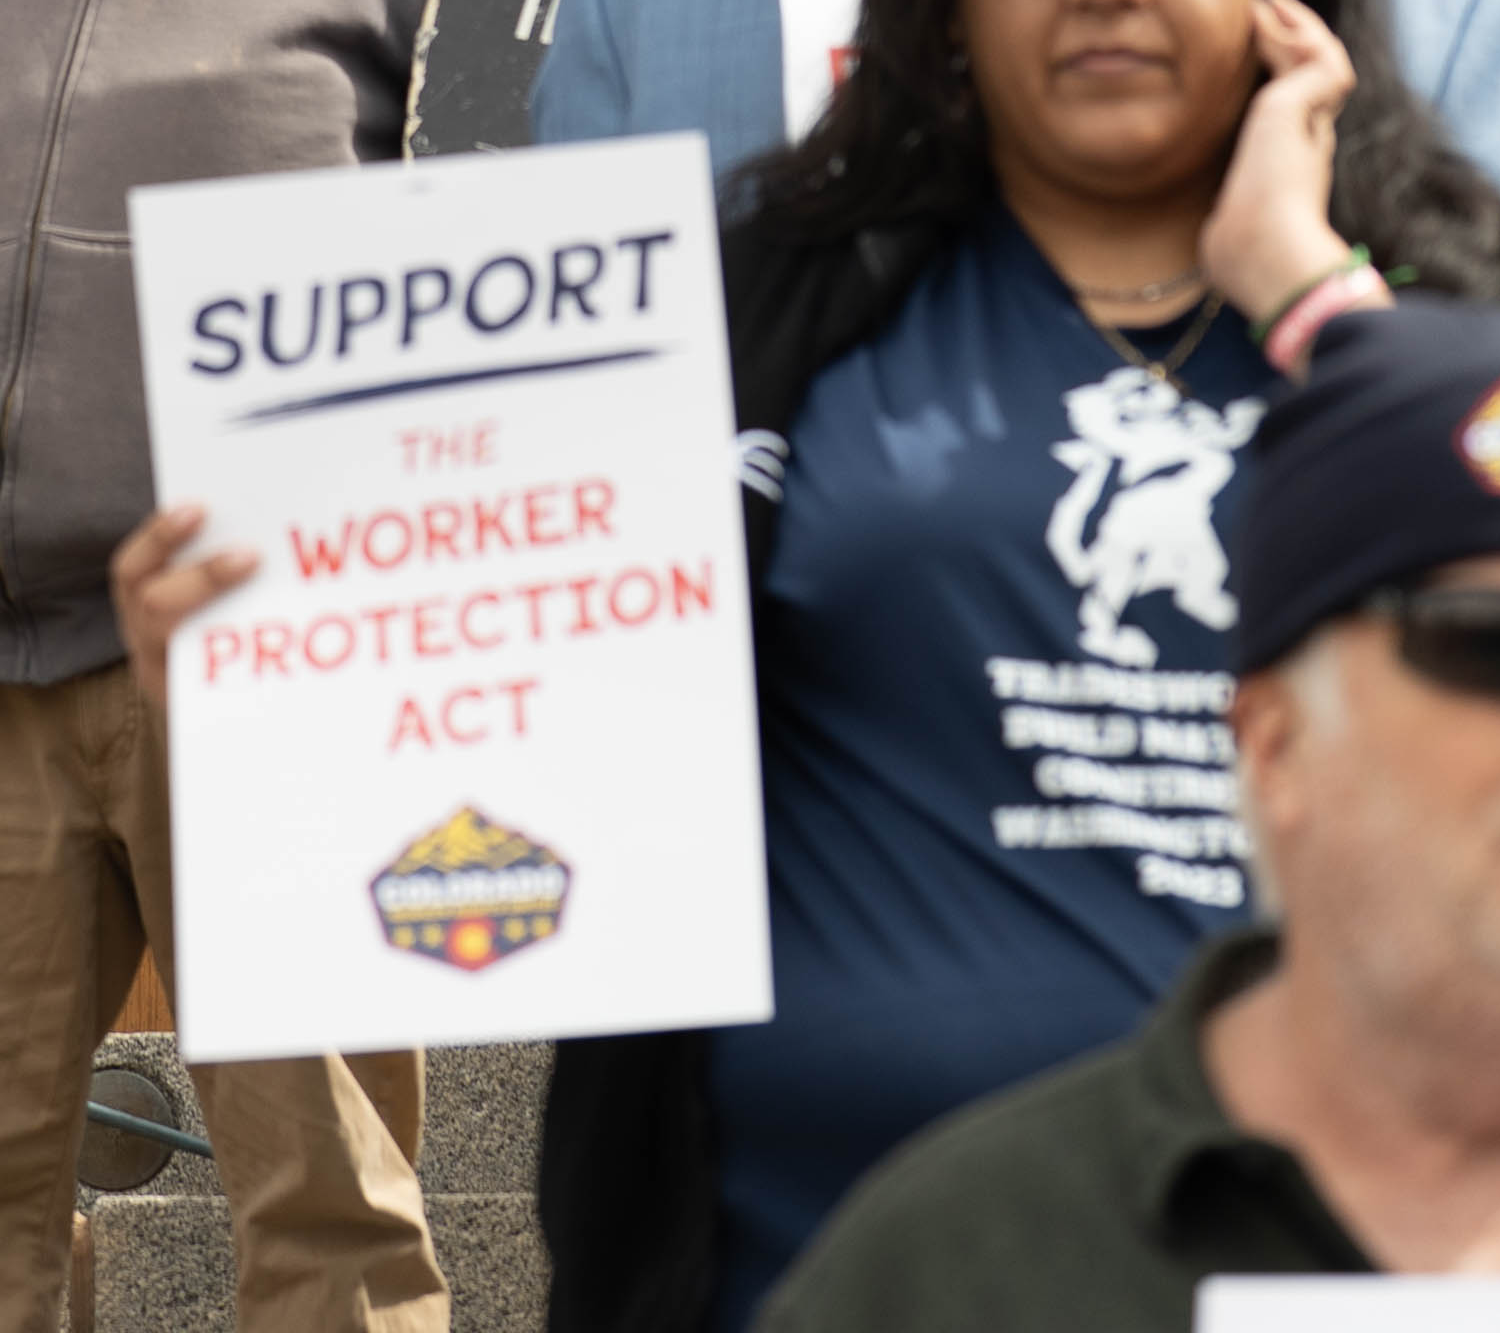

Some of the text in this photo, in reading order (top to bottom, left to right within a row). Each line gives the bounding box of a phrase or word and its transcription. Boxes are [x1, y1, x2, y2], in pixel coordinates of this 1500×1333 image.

[189, 232, 675, 377] SUPPORT
[398, 419, 499, 473] THE
[290, 477, 617, 583] WORKER
[203, 561, 716, 688] PROTECTION
[387, 680, 541, 754] ACT
